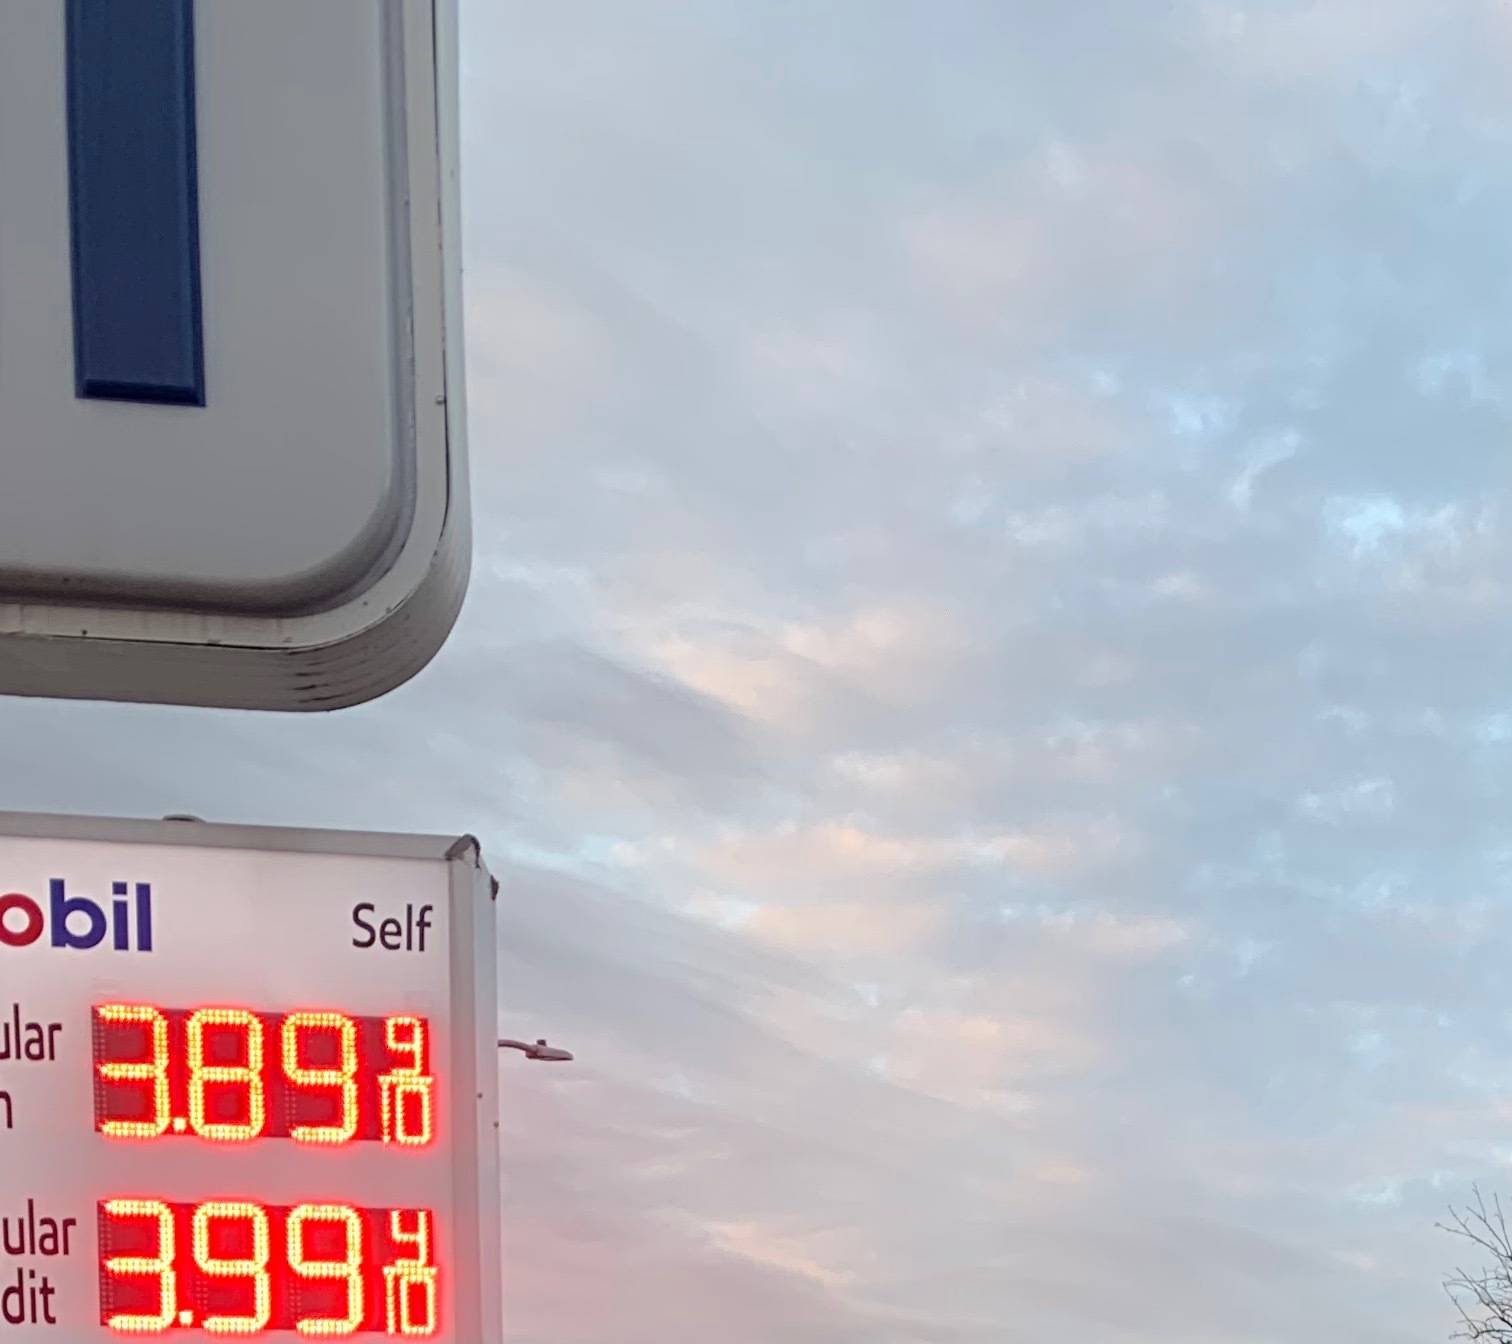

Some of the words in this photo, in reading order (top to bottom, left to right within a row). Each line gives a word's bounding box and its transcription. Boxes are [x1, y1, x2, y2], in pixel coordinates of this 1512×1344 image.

[352, 902, 433, 952] Self
[3, 1198, 77, 1256] ular
[2, 1267, 57, 1325] dit
